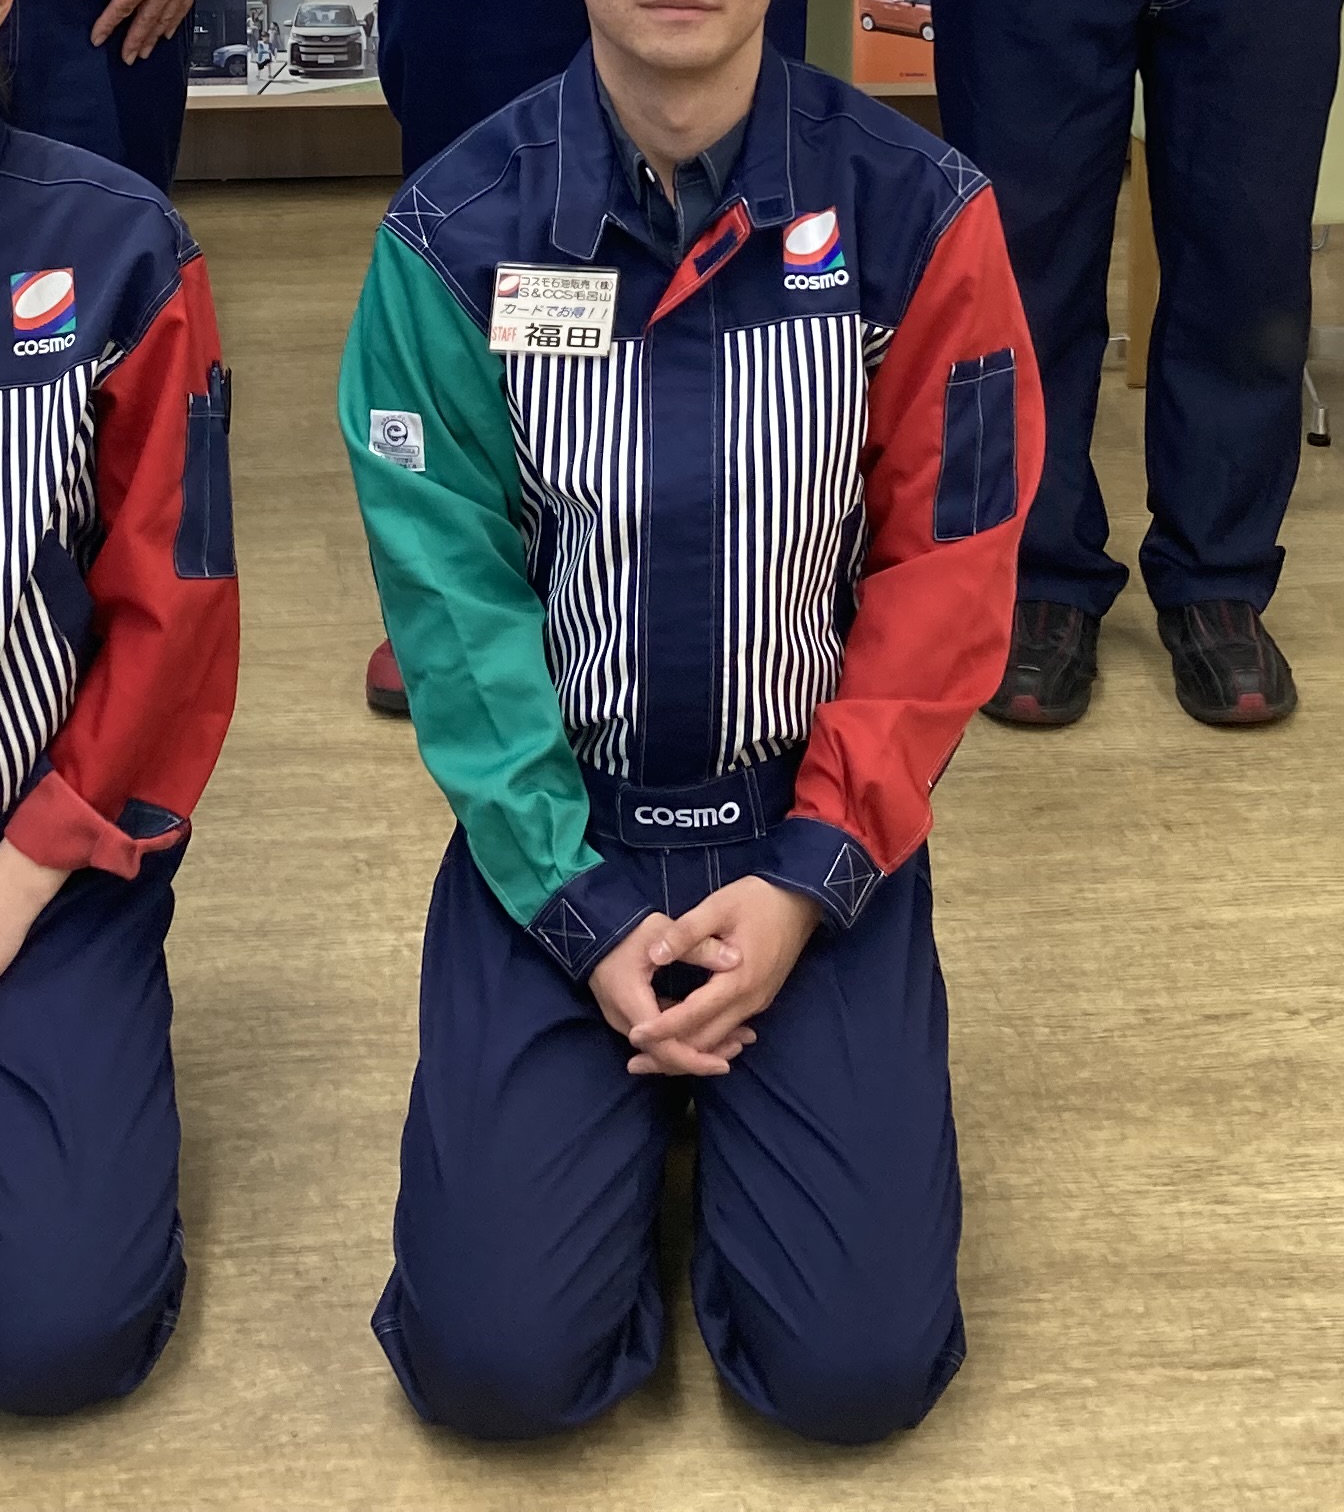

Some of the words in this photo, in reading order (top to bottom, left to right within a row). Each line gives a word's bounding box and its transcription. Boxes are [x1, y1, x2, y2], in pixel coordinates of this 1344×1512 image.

[783, 269, 850, 290] COSMO
[12, 333, 76, 356] COSMO
[491, 326, 518, 342] STAFF
[524, 322, 601, 349] 福田
[634, 800, 741, 828] COSMO
